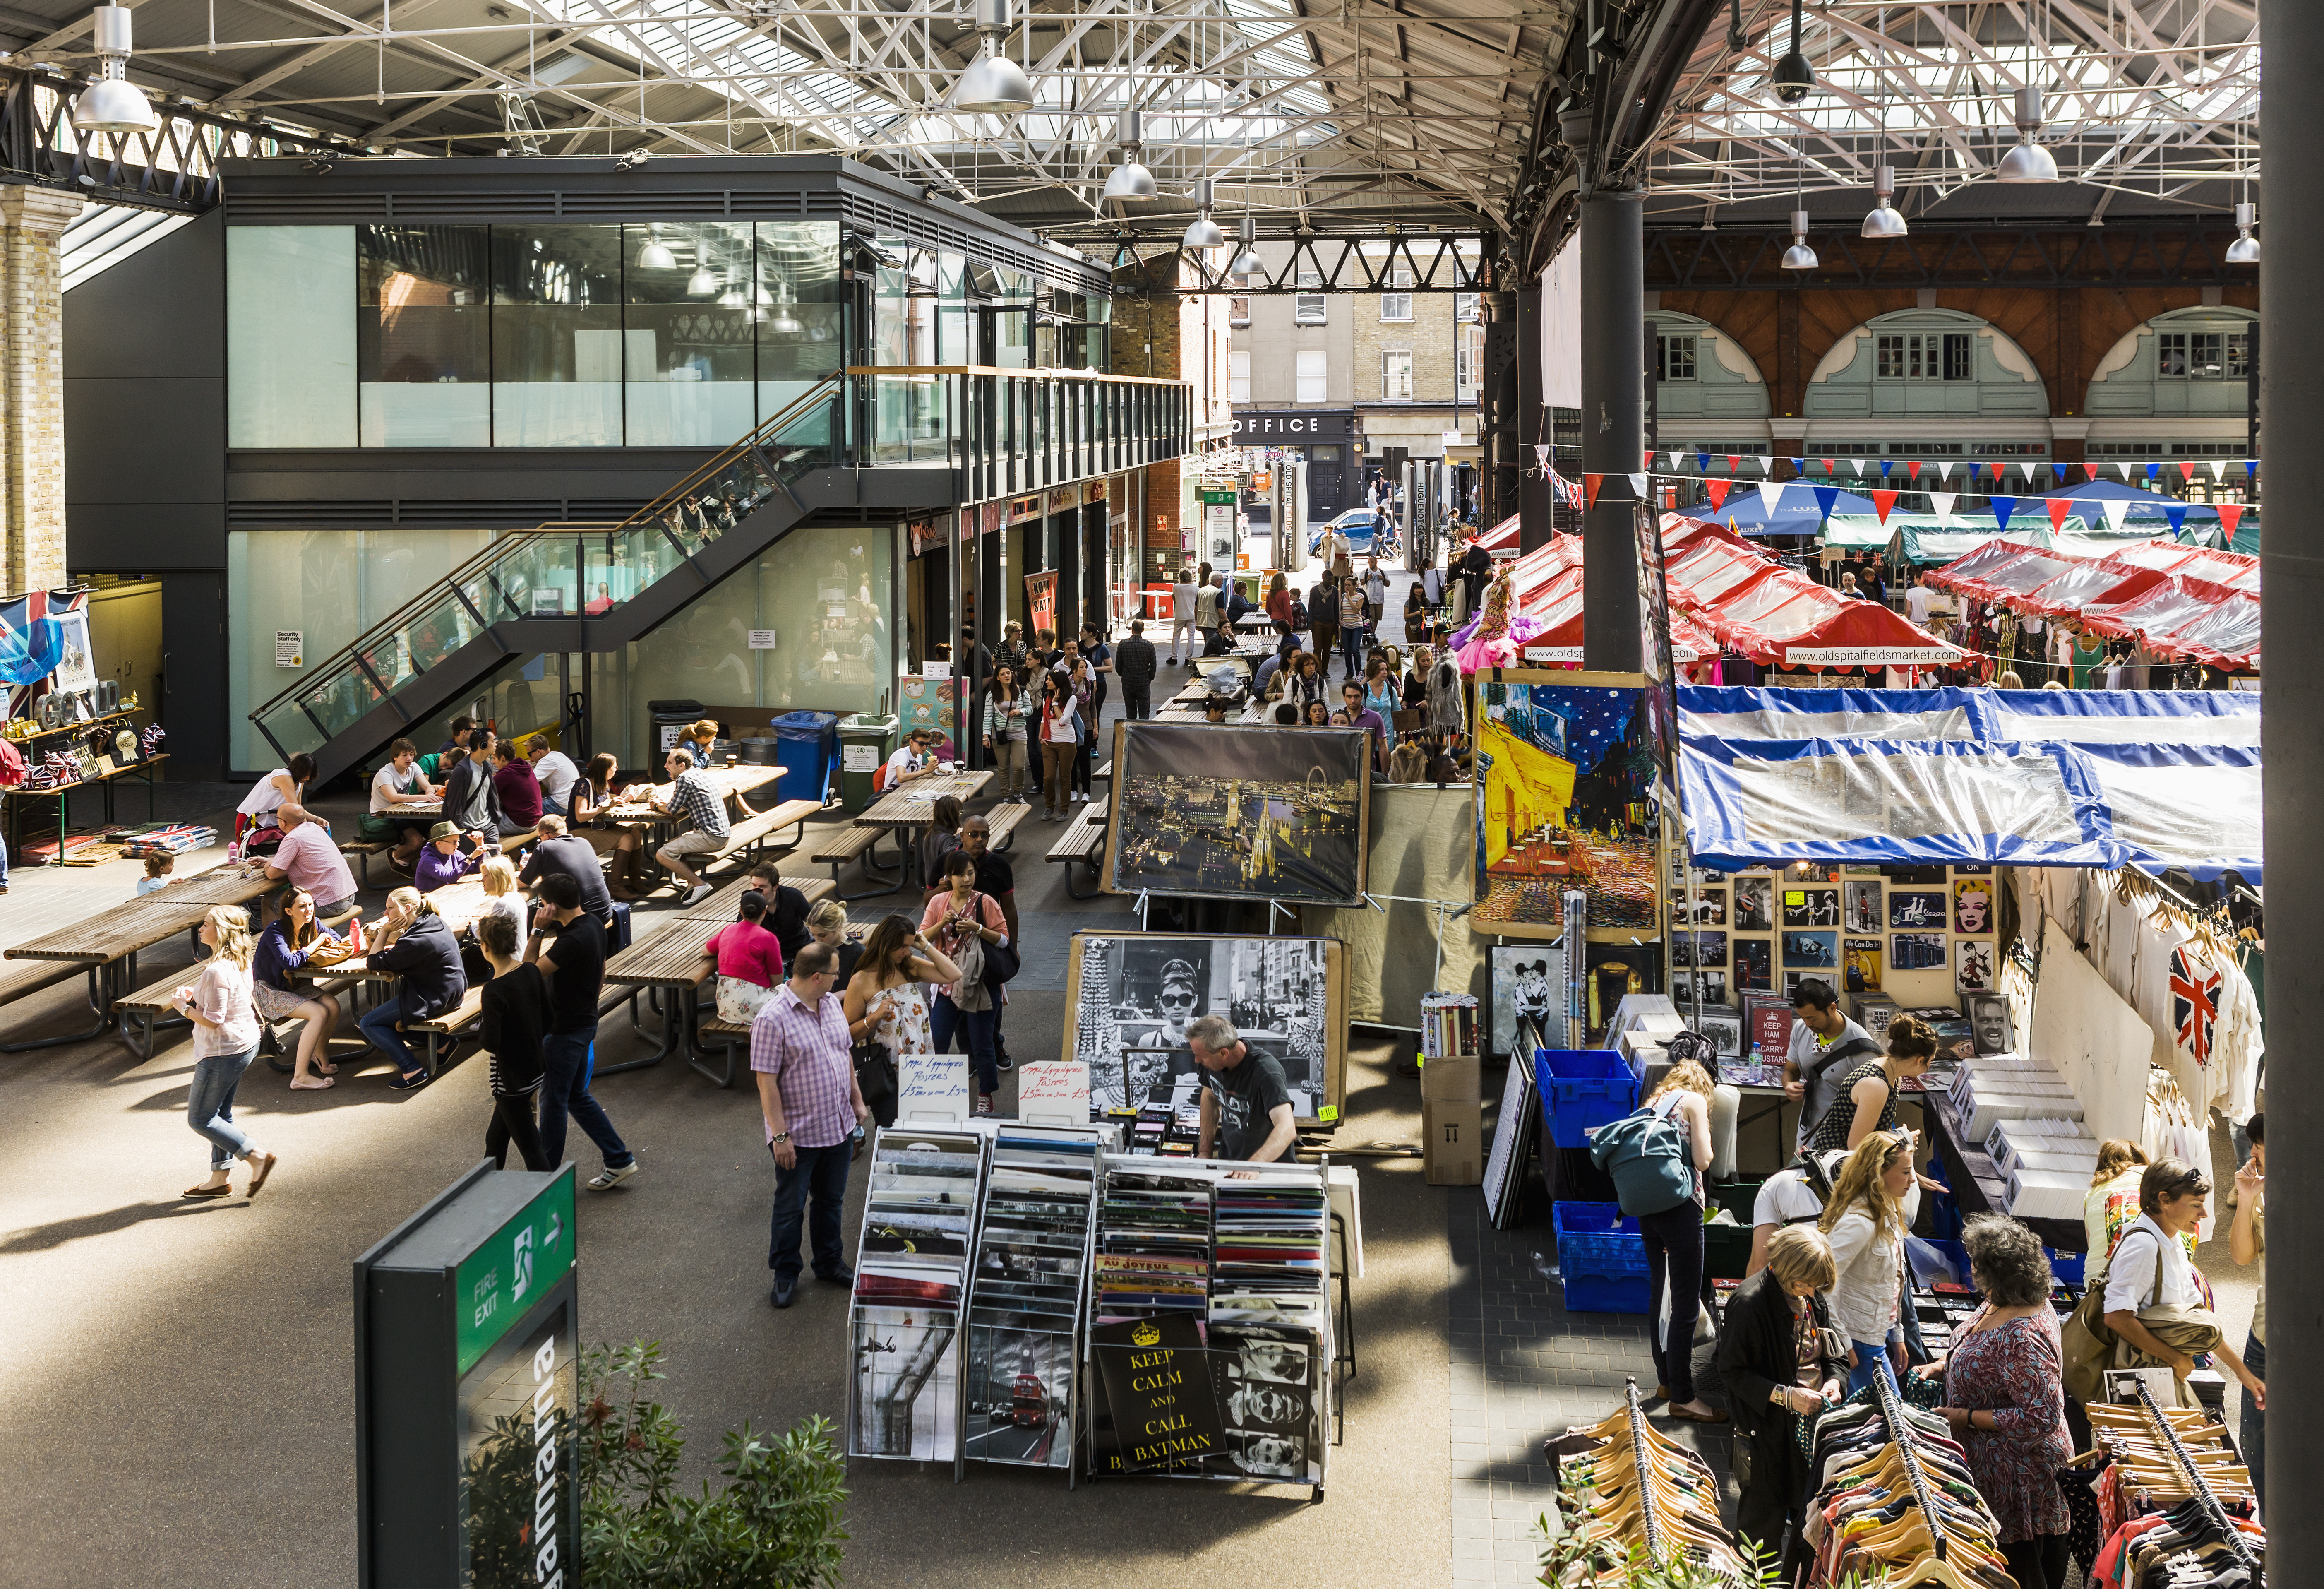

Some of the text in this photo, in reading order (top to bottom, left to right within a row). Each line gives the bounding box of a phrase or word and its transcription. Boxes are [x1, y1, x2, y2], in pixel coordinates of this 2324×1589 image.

[1232, 418, 1318, 433] OFFICE
[1033, 579, 1049, 595] KOTA
[1034, 597, 1051, 613] SATY
[1789, 649, 1959, 662] www.oldspitalfieldsmarket.com
[65, 676, 87, 684] LONDON
[34, 680, 120, 731] GOLD
[73, 744, 90, 759] STAY
[1924, 908, 1946, 916] Vespa
[1762, 1055, 1787, 1063] USTARD
[1104, 1256, 1119, 1268] AU
[475, 1266, 498, 1302] FIRE
[475, 1290, 498, 1328] EXIT
[1130, 1350, 1174, 1370] KEEP
[1133, 1370, 1183, 1392] CALM
[1150, 1395, 1175, 1409] AND
[1145, 1414, 1192, 1435] CALL
[1135, 1434, 1211, 1462] BATMAN
